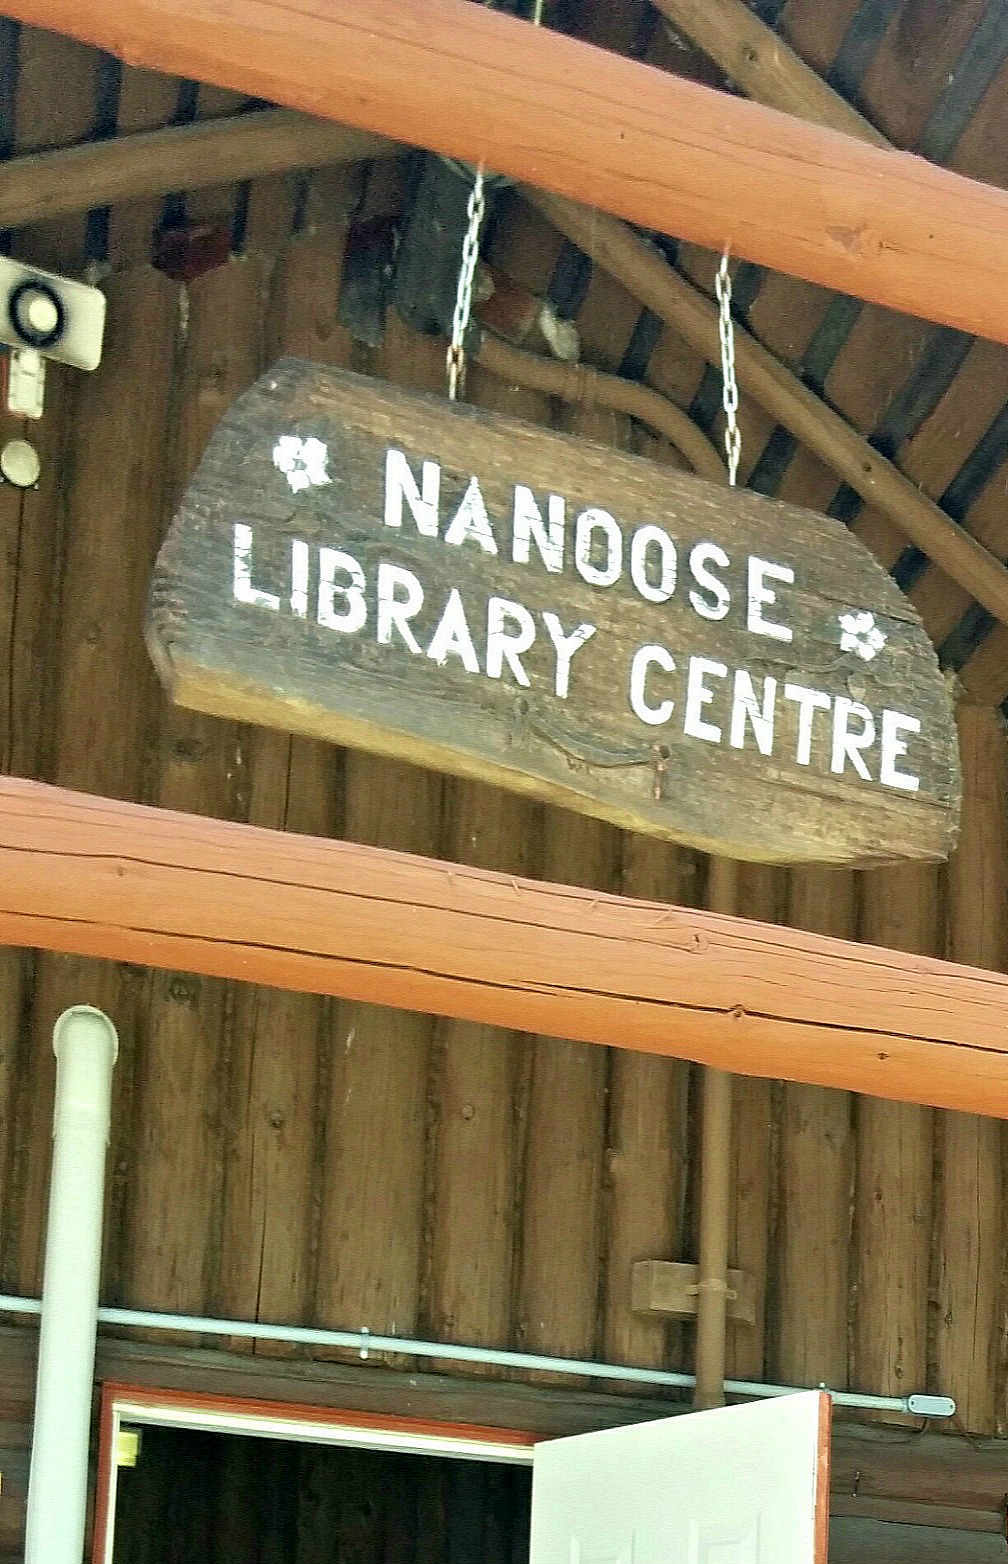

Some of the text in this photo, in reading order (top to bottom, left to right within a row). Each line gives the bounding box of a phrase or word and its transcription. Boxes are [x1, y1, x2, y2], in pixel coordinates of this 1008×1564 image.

[232, 523, 922, 792] LIBRARY CENTRE
[384, 449, 795, 643] NANOOSE
